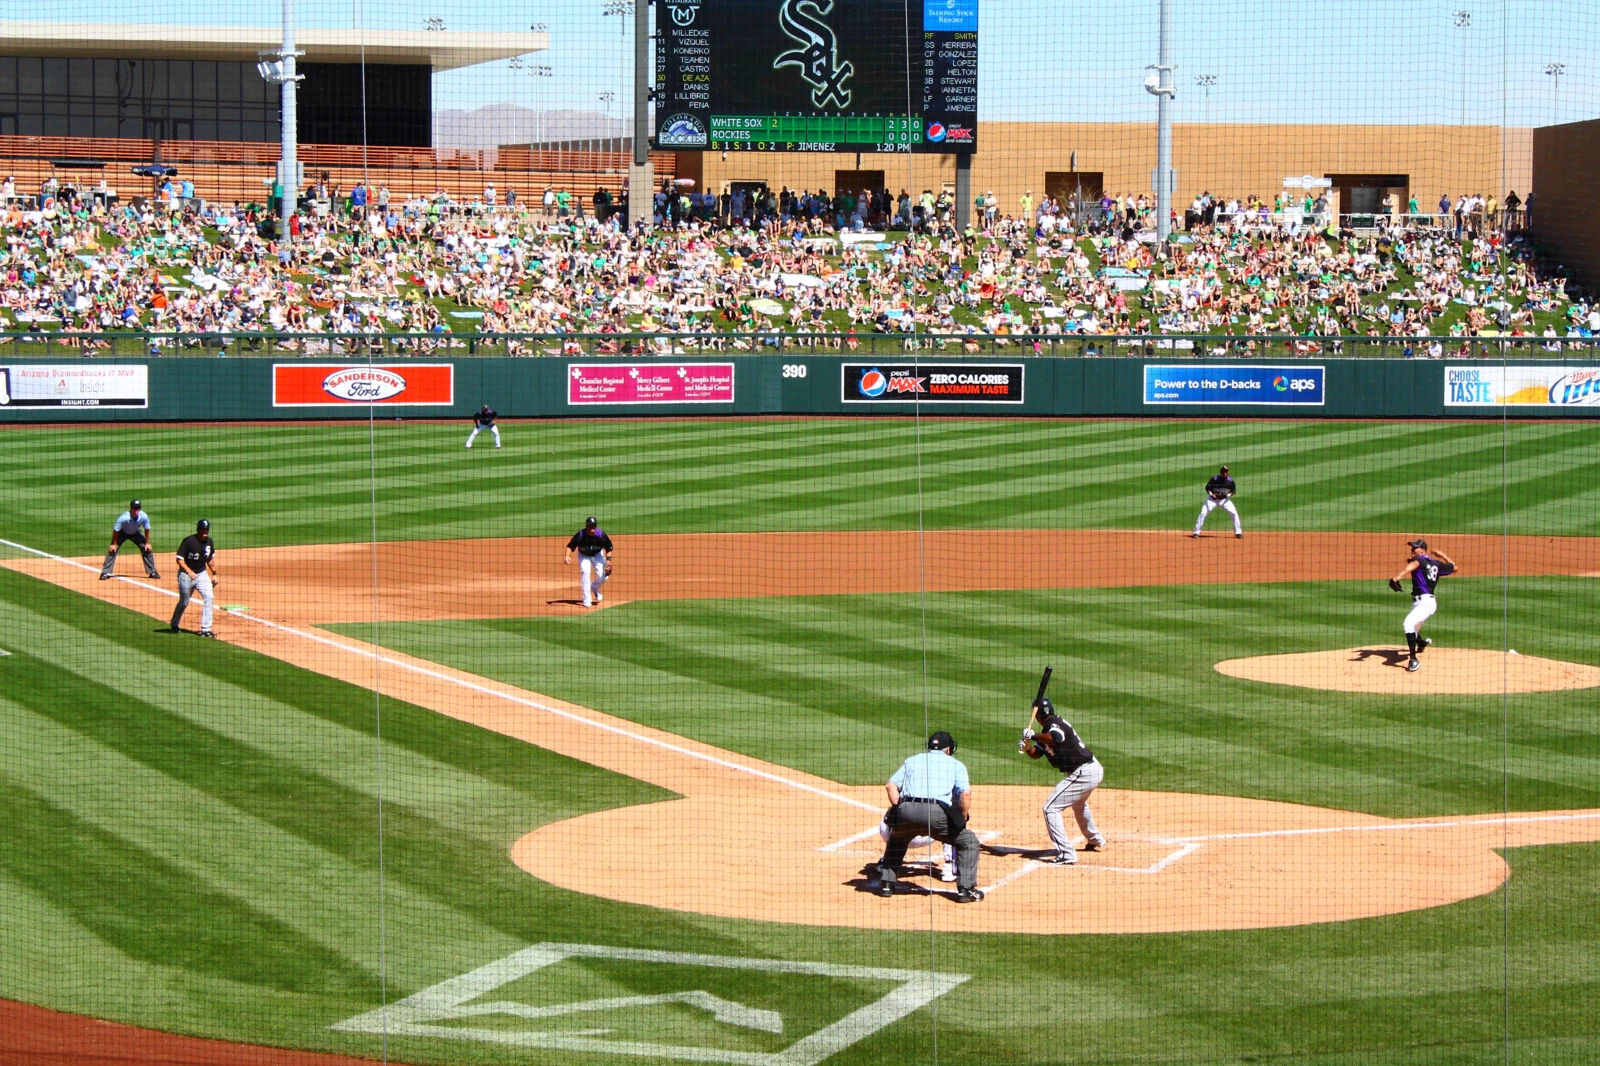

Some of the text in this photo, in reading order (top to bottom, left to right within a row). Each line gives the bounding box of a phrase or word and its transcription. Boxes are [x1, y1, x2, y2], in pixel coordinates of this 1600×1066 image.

[712, 118, 741, 126] WHITE
[744, 118, 762, 127] SOX
[772, 119, 777, 127] 2
[712, 131, 750, 139] ROCKIES
[946, 128, 972, 139] MAX
[747, 142, 751, 150] 1
[770, 142, 775, 150] 2
[798, 142, 835, 151] JIMENEZ
[876, 143, 894, 151] 1:20
[897, 143, 909, 151] PM
[782, 365, 806, 378] 390
[1449, 370, 1480, 381] CHOOSE
[330, 373, 398, 388] SANDERSON
[603, 377, 624, 385] Regional
[637, 377, 651, 385] Mercy
[710, 376, 729, 384] Hospital
[930, 374, 1009, 384] ZERO CALORIES
[1568, 371, 1598, 383] Miller
[348, 382, 381, 396] Ford
[887, 377, 927, 393] MAX
[930, 385, 1008, 394] MAXIMUM TASTE
[1154, 380, 1186, 388] Power
[1201, 380, 1217, 388] the
[1220, 380, 1261, 389] D-backs
[1290, 379, 1315, 392] aps
[1450, 382, 1494, 403] TASTE.
[188, 552, 200, 560] 23
[1426, 564, 1438, 581] 38
